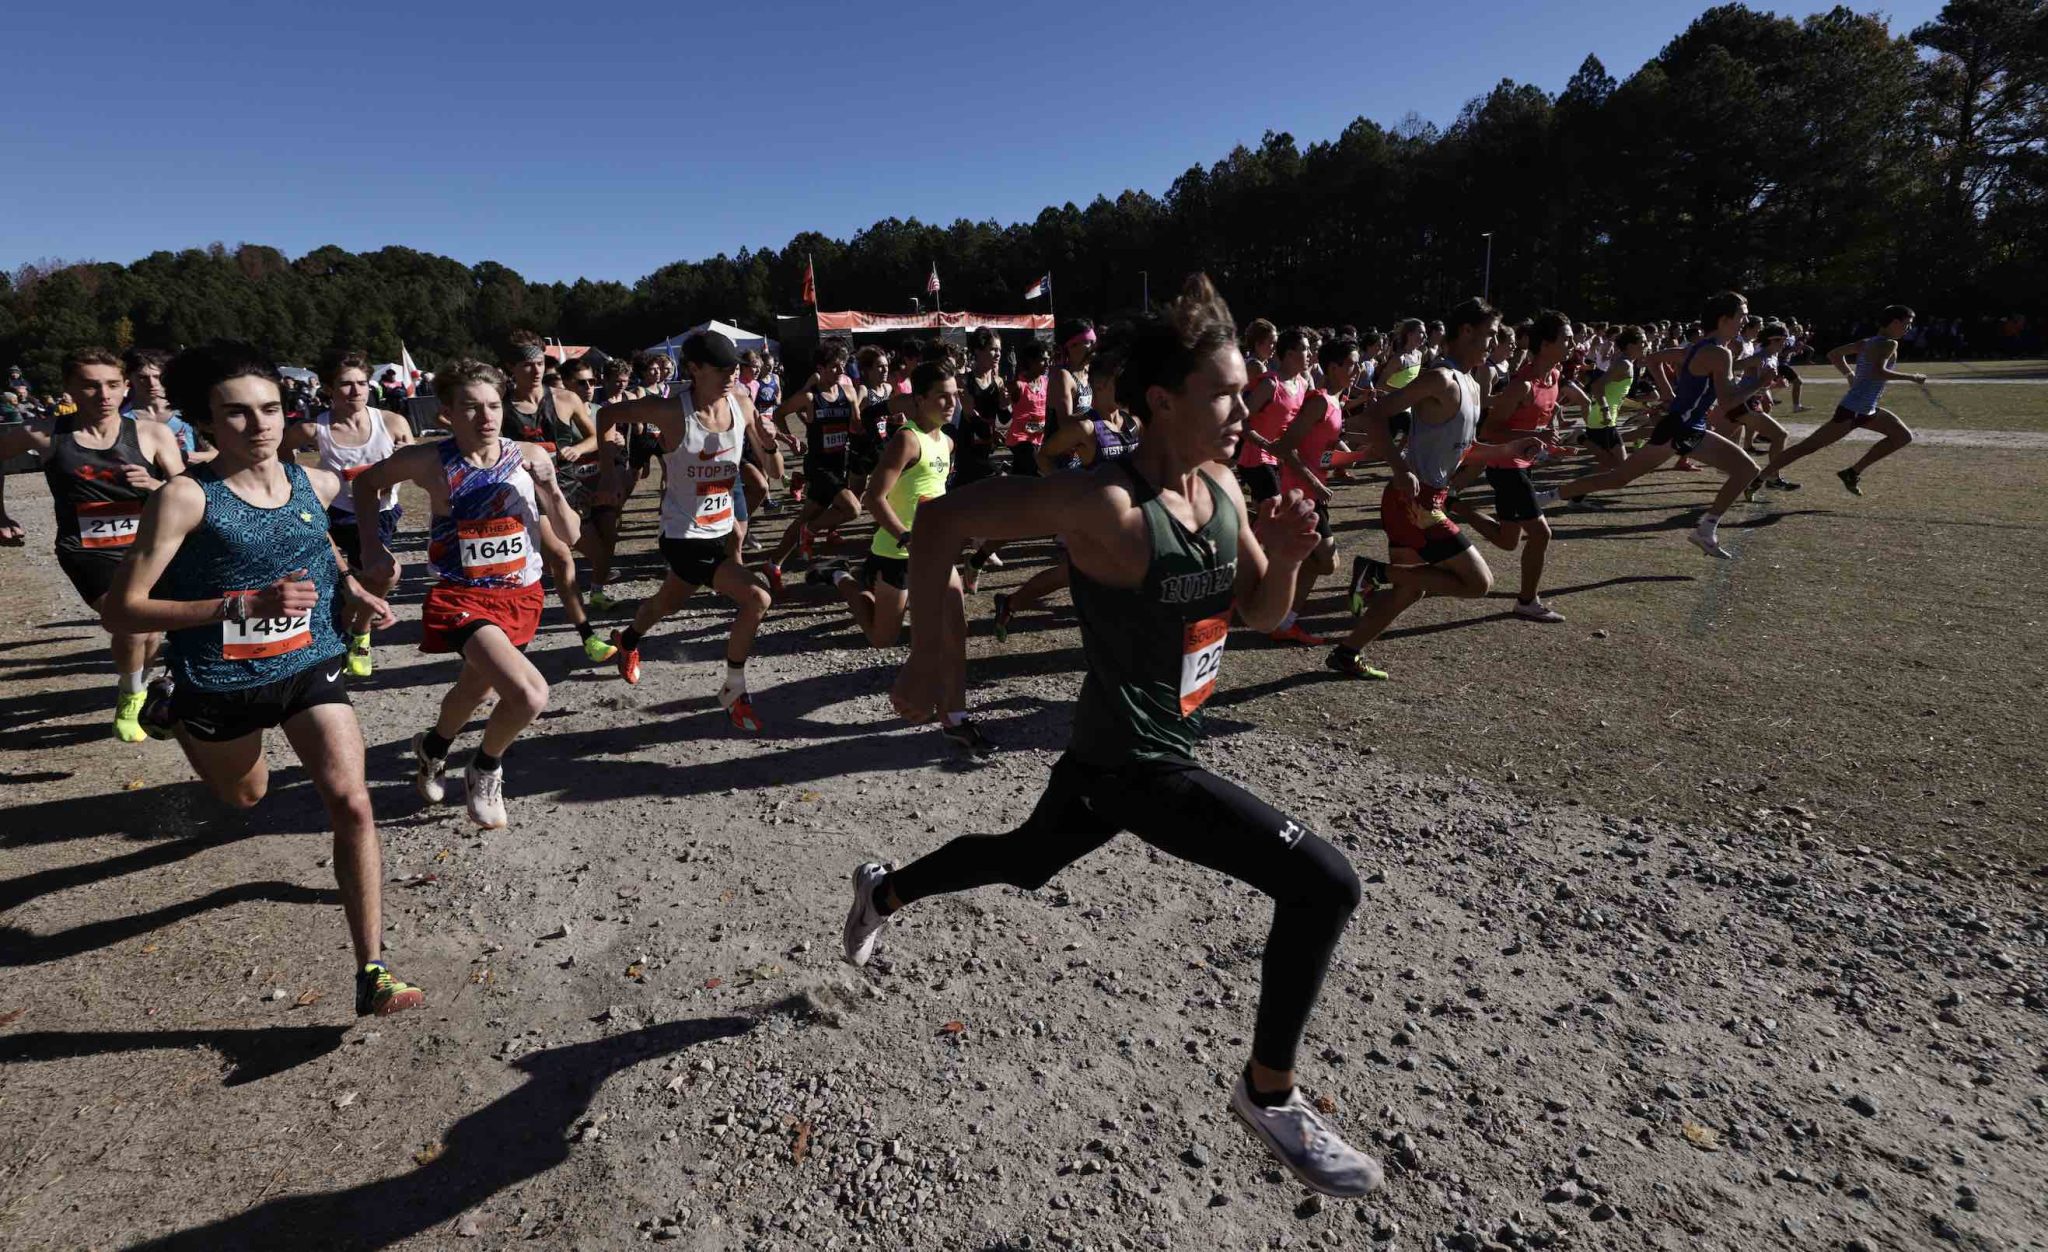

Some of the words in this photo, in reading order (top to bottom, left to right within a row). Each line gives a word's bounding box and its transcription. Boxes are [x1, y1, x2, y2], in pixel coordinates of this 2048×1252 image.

[687, 466, 720, 478] STOP
[91, 518, 134, 533] 214
[462, 522, 519, 535] SOUTHEAST
[465, 537, 522, 560] 1645
